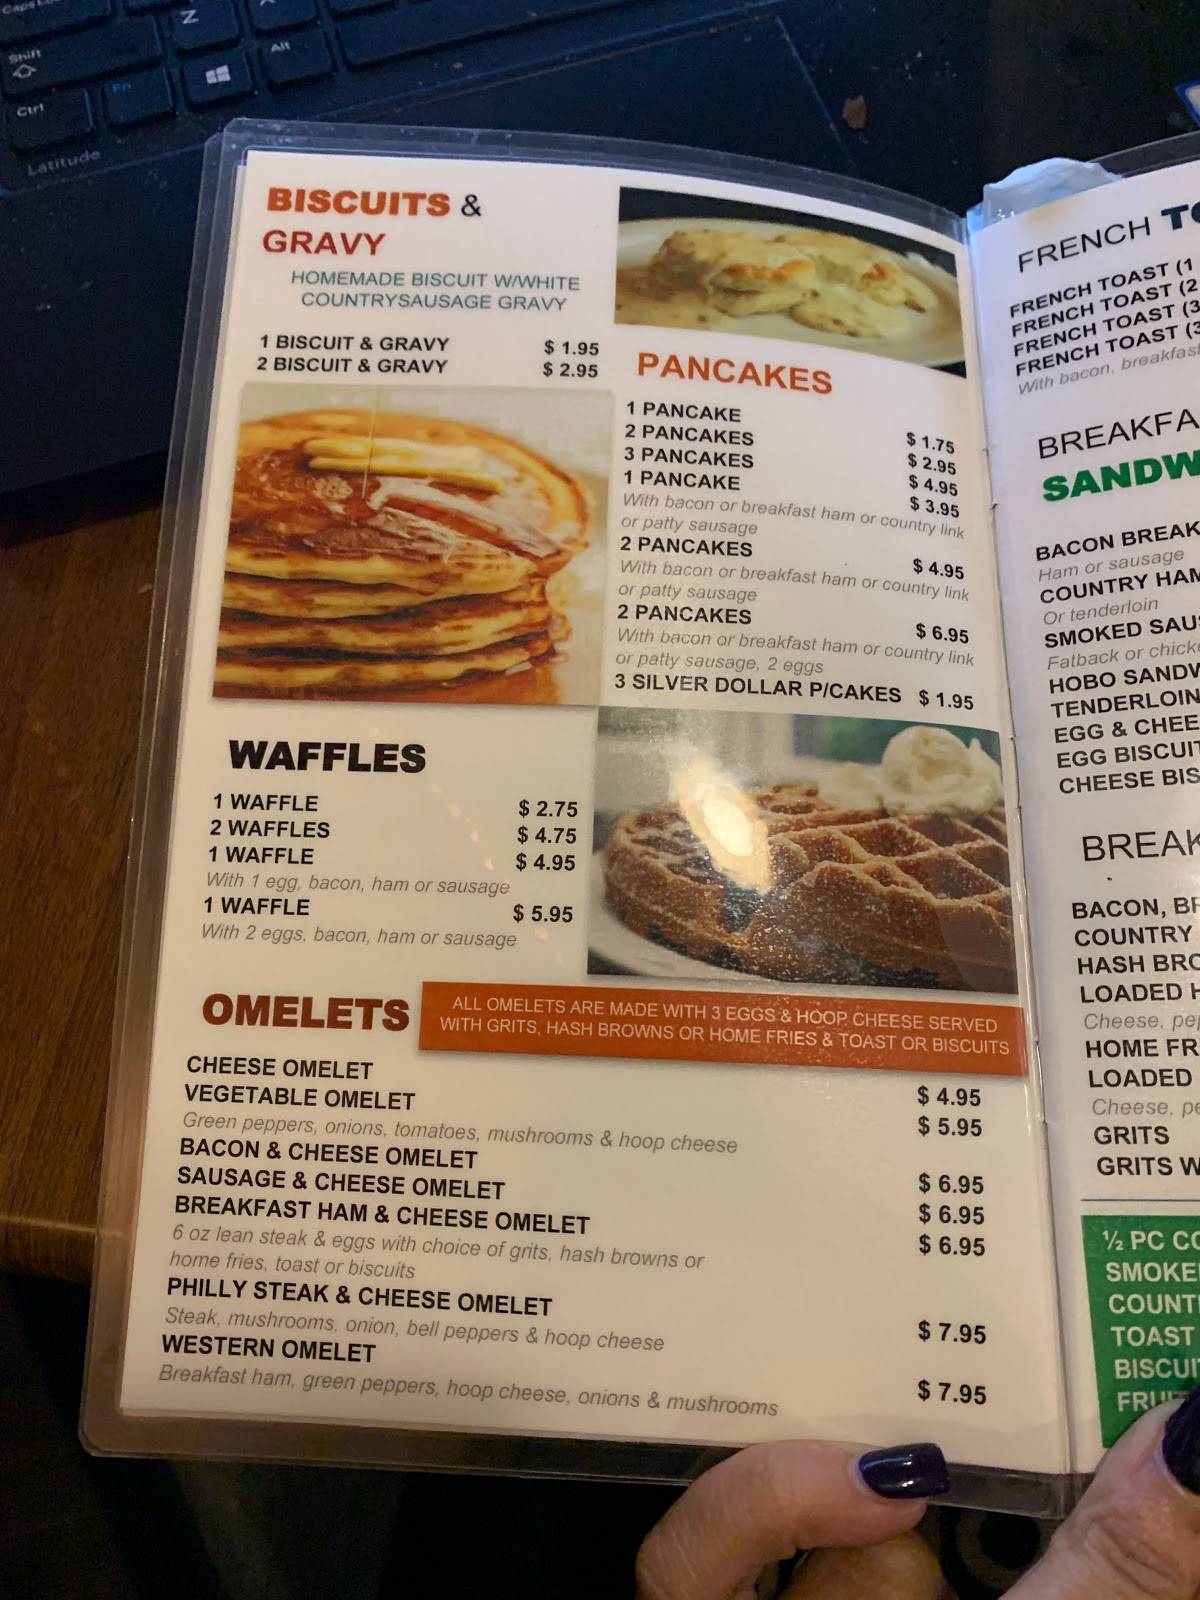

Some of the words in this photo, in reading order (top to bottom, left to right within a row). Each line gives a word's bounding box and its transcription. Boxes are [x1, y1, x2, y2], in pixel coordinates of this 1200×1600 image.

[181, 9, 199, 24] Z
[8, 49, 41, 63] Shift
[271, 42, 290, 52] Alt
[17, 103, 44, 116] Ctrl
[28, 150, 100, 177] Latitude
[267, 187, 450, 217] BISCUITS
[461, 194, 481, 217] &
[263, 230, 385, 256] GRAVY
[1018, 216, 1151, 273] FRENCH
[291, 271, 405, 286] HOMEMADE
[412, 273, 488, 287] BISCUIT
[494, 274, 579, 291] W/WHITE
[1009, 282, 1092, 318] FRENCH
[1098, 263, 1169, 291] TOAST
[498, 296, 566, 311] GRAVY
[1012, 303, 1094, 337] FRENCH
[1100, 284, 1171, 311] TOAST
[261, 334, 268, 348] 1
[276, 335, 354, 350] BISCUIT
[360, 337, 373, 350] &
[380, 337, 449, 351] GRAVY
[544, 339, 554, 355] $
[562, 341, 599, 356] 1.95
[257, 356, 267, 370] 2
[274, 357, 352, 372] BISCUIT
[358, 358, 370, 373] &
[378, 359, 447, 373] GRAVY
[543, 361, 553, 377] $
[560, 363, 598, 378] 2.95
[638, 352, 832, 394] PANCAKES
[627, 401, 634, 415] 1
[643, 402, 741, 422] PANCAKE
[625, 424, 636, 438] 2
[643, 425, 754, 446] PANCAKES
[907, 432, 916, 447] $
[922, 436, 955, 454] 1.75
[624, 447, 634, 461] 3
[642, 447, 754, 468] PANCAKES
[624, 470, 632, 484] 1
[641, 471, 740, 491] PANCAKE
[621, 517, 639, 527] or
[642, 517, 684, 533] patty
[689, 520, 758, 537] sausage
[624, 493, 659, 507] With
[665, 495, 714, 510] bacon
[720, 501, 737, 512] or
[741, 500, 816, 519] breakfast
[821, 506, 855, 522] ham
[860, 514, 876, 524] or
[881, 516, 936, 536] country
[940, 523, 964, 539] link
[1039, 566, 1079, 581] Ham
[1085, 563, 1103, 574] or
[1108, 551, 1185, 570] sausage
[615, 673, 625, 688] 3
[632, 674, 708, 692] SILVER
[716, 677, 802, 696] DOLLAR
[810, 682, 901, 703] P/CAKES
[919, 689, 929, 707] $
[936, 692, 973, 710] 1.95
[1051, 688, 1200, 718] TENDERLOIN
[229, 740, 426, 773] WAFFLES
[1059, 771, 1155, 794] CHEESE
[214, 793, 222, 809] 1
[231, 794, 318, 811] WAFFLE
[519, 799, 529, 818] $
[536, 801, 577, 817] 2.75
[210, 819, 221, 835] 2
[228, 820, 330, 838] WAFFLES
[209, 846, 217, 862] 1
[226, 846, 314, 864] WAFFLE
[208, 872, 244, 887] With
[253, 873, 259, 888] 1
[308, 875, 364, 892] bacon,
[372, 876, 409, 891] ham
[414, 881, 433, 892] or
[437, 881, 510, 898] sausage
[204, 897, 212, 913] 1
[221, 897, 310, 915] WAFFLE
[513, 904, 524, 923] $
[531, 905, 573, 923] 5.95
[1075, 925, 1192, 947] COUNTRY
[1080, 983, 1182, 1003] LOADED
[203, 993, 409, 1031] OMELETS
[452, 996, 482, 1010] ALL
[487, 997, 565, 1013] OMELETS
[570, 1000, 604, 1015] ARE
[610, 1002, 658, 1017] MADE
[663, 1004, 706, 1019] WITH
[712, 1006, 721, 1020] 3
[726, 1006, 776, 1022] EGGS
[780, 1009, 792, 1023] &
[795, 1008, 847, 1025] HOOP
[853, 1012, 924, 1029] CHEESE
[929, 1016, 997, 1033] SERVED
[440, 1017, 482, 1031] WITH
[487, 1019, 540, 1035] GRITS,
[547, 1021, 592, 1036] HASH
[598, 1022, 674, 1039] BROWNS
[679, 1026, 704, 1040] OR
[710, 1027, 761, 1043] HOME
[767, 1030, 817, 1046] FRIES
[822, 1032, 833, 1047] &
[838, 1033, 896, 1049] TOAST
[902, 1036, 927, 1051] OR
[932, 1038, 1010, 1056] BISCUITS
[187, 1056, 276, 1076] CHEESE
[283, 1059, 373, 1080] OMELET
[185, 1084, 317, 1106] VEGETABLE
[325, 1089, 416, 1110] OMELET
[918, 1085, 929, 1106] $
[937, 1087, 981, 1107] 4.95
[183, 1112, 237, 1129] Green
[241, 1118, 316, 1135] peppers,
[488, 1127, 594, 1146] mushrooms
[600, 1130, 612, 1147] &
[619, 1131, 665, 1153] hoop
[671, 1135, 737, 1154] cheese
[1094, 1126, 1169, 1145] GRITS
[180, 1138, 259, 1158] BACON
[266, 1141, 281, 1159] &
[289, 1143, 379, 1164] CHEESE
[386, 1147, 478, 1169] OMELET
[177, 1166, 286, 1188] SAUSAGE
[292, 1171, 307, 1189] &
[315, 1173, 405, 1194] CHEESE
[413, 1177, 505, 1200] OMELET
[175, 1195, 311, 1219] BREAKFAST
[318, 1202, 367, 1222] HAM
[374, 1205, 389, 1223] &
[397, 1206, 488, 1229] CHEESE
[495, 1212, 590, 1234] OMELET
[1130, 1231, 1164, 1250] PC
[168, 1277, 248, 1298] PHILLY
[254, 1281, 329, 1303] STEAK
[336, 1285, 351, 1304] &
[359, 1287, 450, 1310] CHEESE
[458, 1293, 552, 1316] OMELET
[1110, 1326, 1195, 1346] TOAST
[162, 1334, 274, 1357] WESTERN
[282, 1340, 376, 1363] OMELET
[918, 1379, 930, 1402] $
[939, 1382, 986, 1405] 7.95
